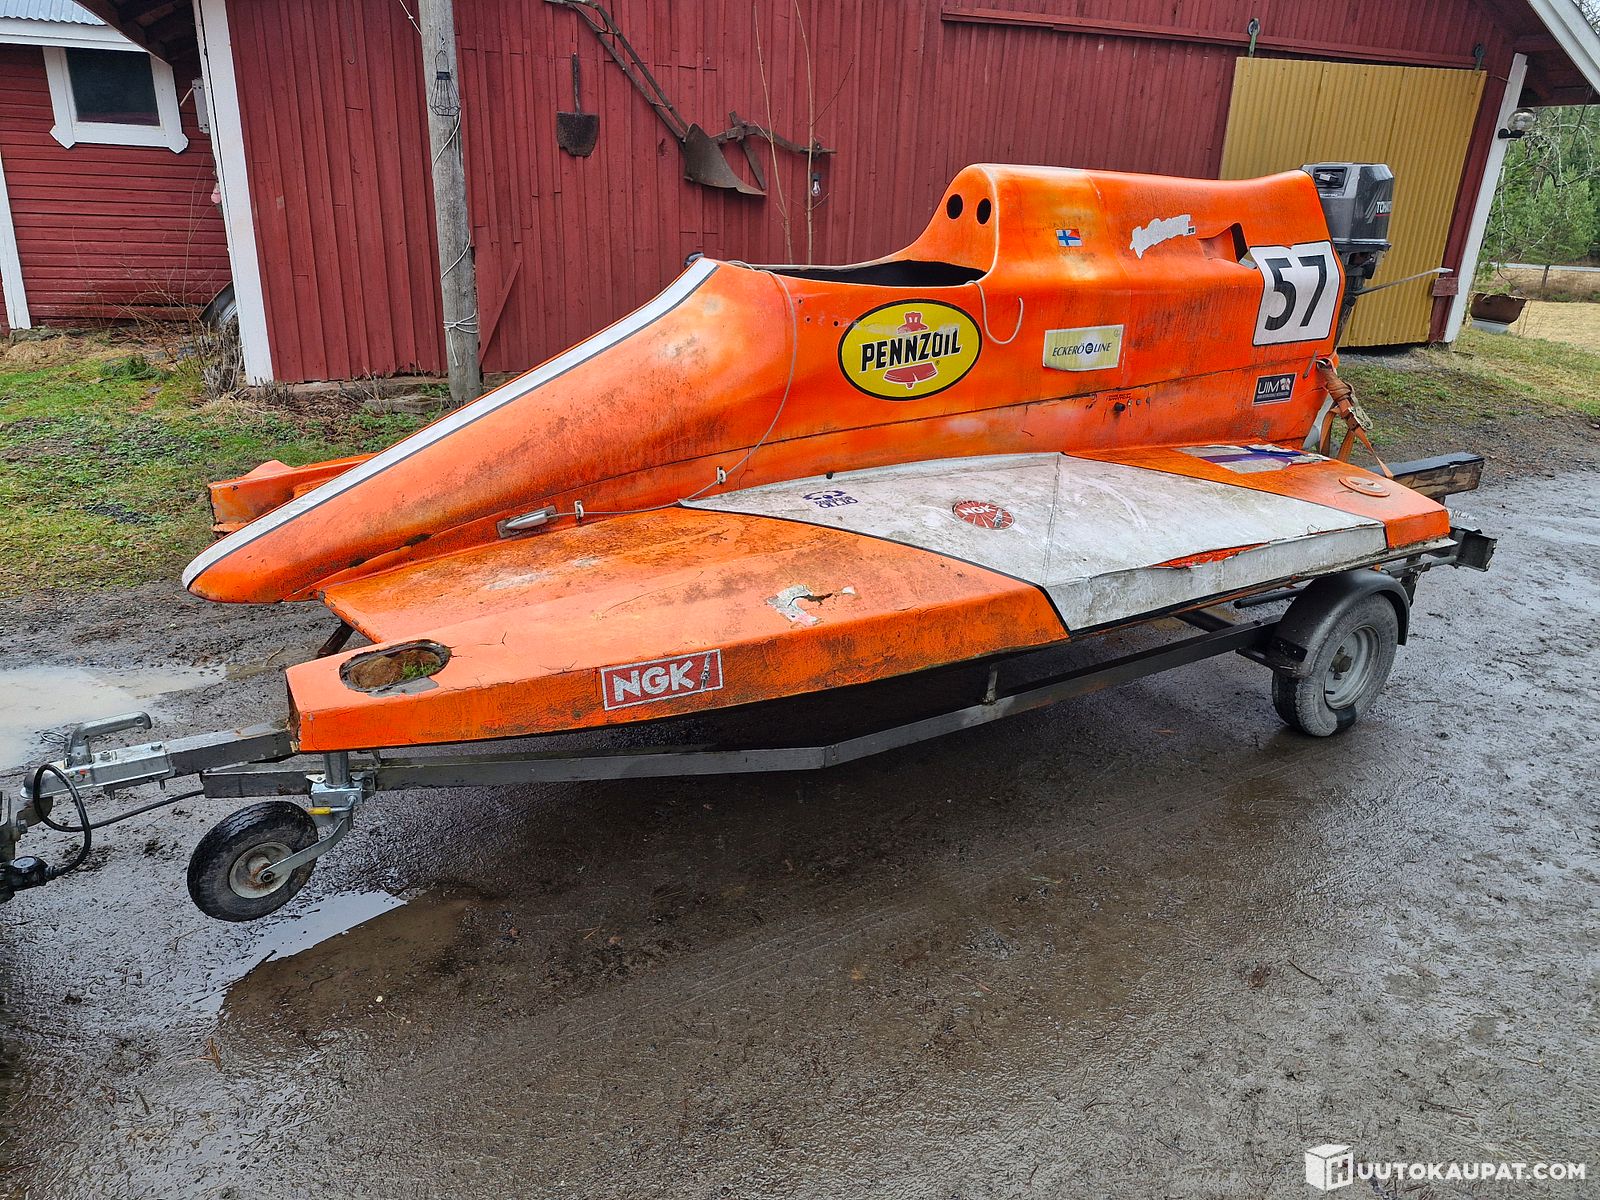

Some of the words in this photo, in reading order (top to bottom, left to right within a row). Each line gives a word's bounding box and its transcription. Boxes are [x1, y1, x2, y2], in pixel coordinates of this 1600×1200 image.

[1263, 254, 1328, 331] 57
[860, 328, 961, 373] PENNZOIL
[1051, 342, 1085, 357] ECKERÖ
[1093, 342, 1113, 353] LINE
[1257, 380, 1280, 395] UIM
[958, 504, 997, 516] NGK
[612, 660, 695, 702] NGK
